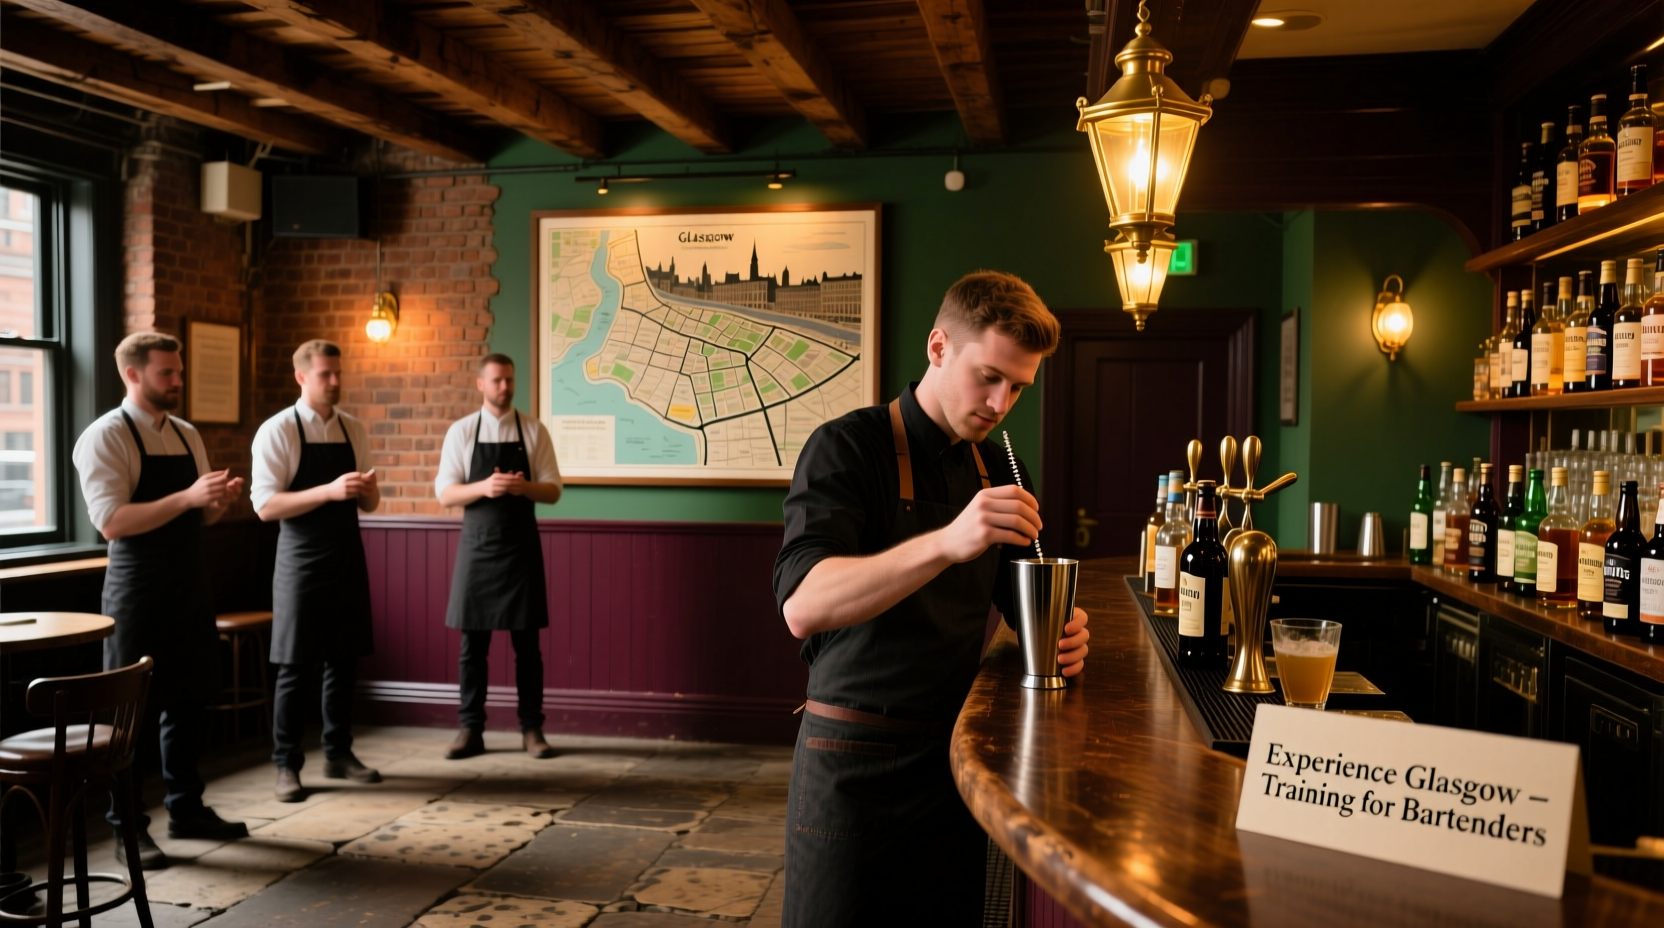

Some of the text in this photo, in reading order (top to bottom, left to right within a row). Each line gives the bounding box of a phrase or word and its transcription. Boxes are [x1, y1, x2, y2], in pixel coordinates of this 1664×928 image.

[1265, 742, 1398, 785] Experience
[1404, 765, 1522, 806] Glasgow
[1261, 772, 1547, 847] Training for Bartenders
